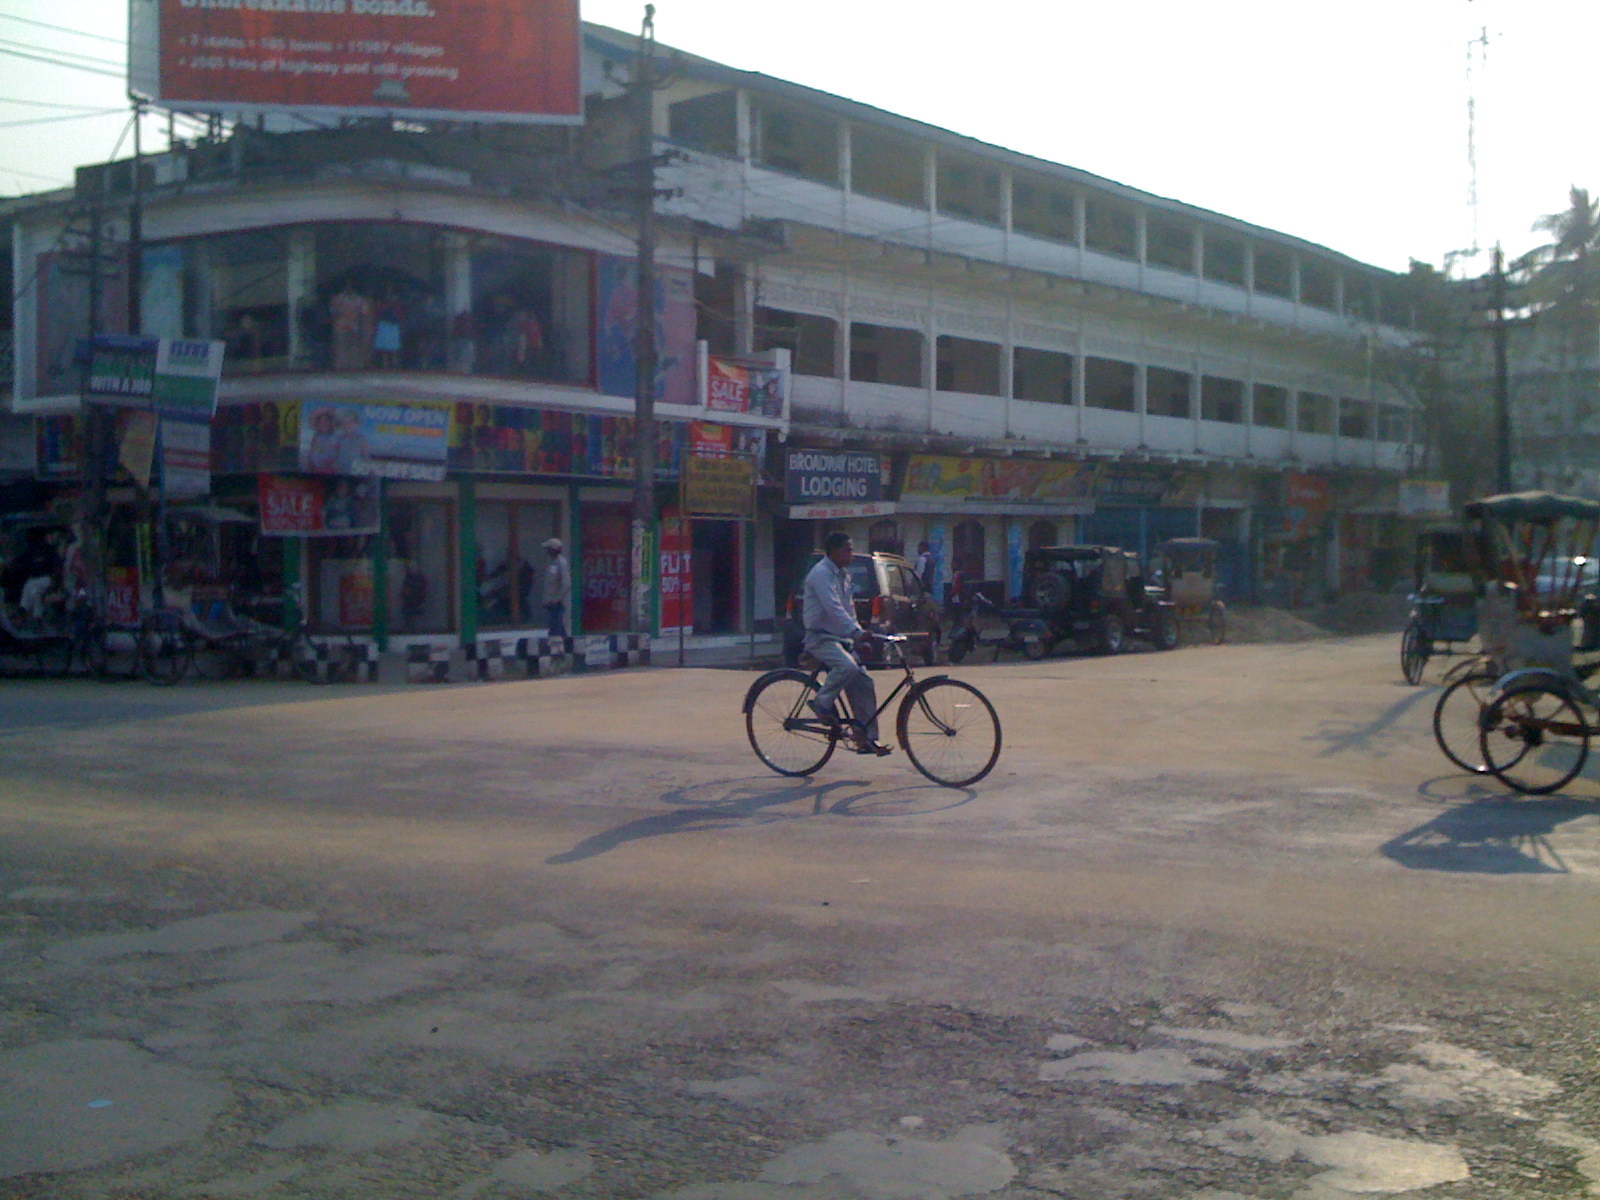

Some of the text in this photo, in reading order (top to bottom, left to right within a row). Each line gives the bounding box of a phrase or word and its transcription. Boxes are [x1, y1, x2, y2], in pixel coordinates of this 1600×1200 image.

[711, 380, 745, 403] SALE
[364, 405, 446, 426] NOW OPEN
[790, 453, 880, 474] BROADWAY HOTEL
[801, 477, 868, 497] LODGING
[267, 492, 314, 516] SALE
[582, 556, 627, 577] SALE
[660, 553, 692, 574] FLT
